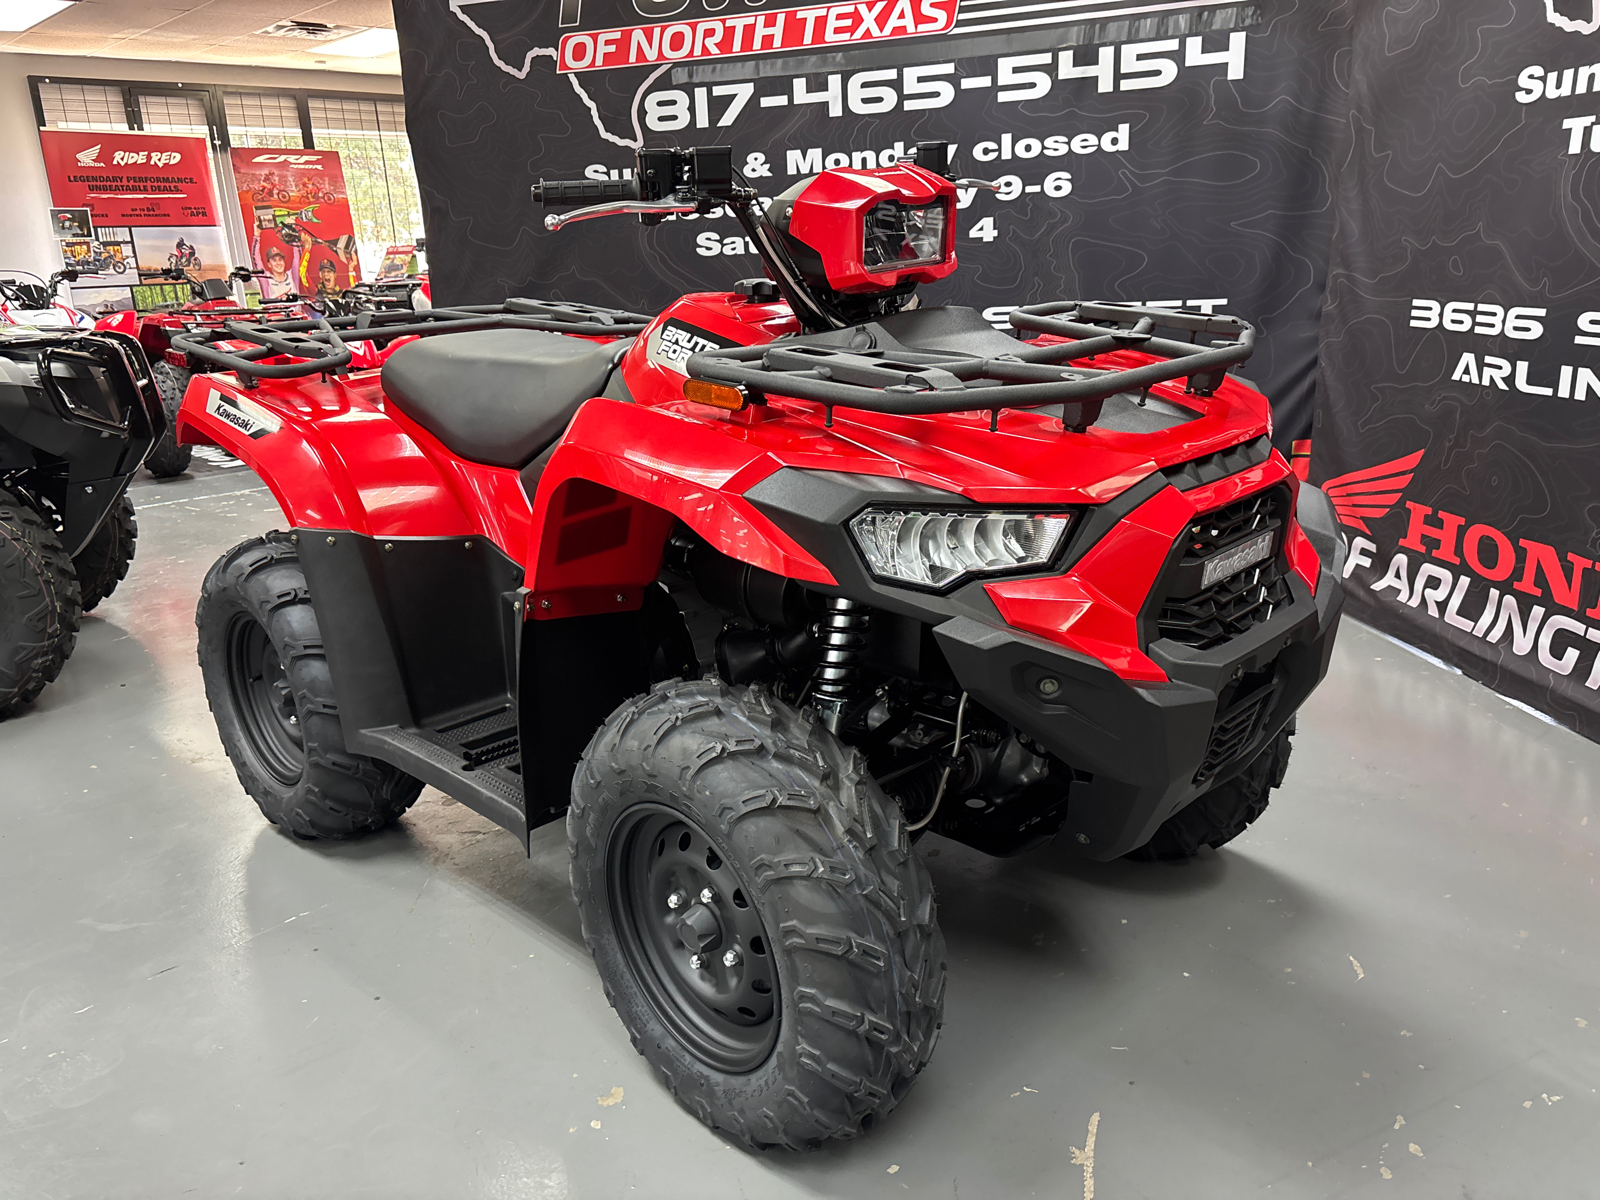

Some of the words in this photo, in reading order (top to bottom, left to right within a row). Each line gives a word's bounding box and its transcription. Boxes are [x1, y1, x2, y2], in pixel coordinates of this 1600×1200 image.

[564, 31, 621, 69] OF
[628, 14, 786, 63] NORTH
[796, 0, 951, 44] TEXAS
[644, 31, 1246, 132] 817-465-5454
[112, 151, 148, 166] RIDE
[150, 151, 182, 168] RED
[251, 154, 323, 163] CRF
[743, 152, 773, 178] &
[972, 123, 1130, 162] closed
[67, 175, 124, 184] LEGENDARY
[126, 176, 197, 185] PERFORMANCE.
[87, 184, 149, 192] UNBEATABLE
[150, 185, 183, 193] DEALS.
[995, 171, 1072, 201] 9-6
[189, 210, 208, 218] APR
[968, 216, 998, 242] 4
[1409, 298, 1548, 341] 3636
[656, 339, 693, 363] FOR
[214, 403, 255, 433] Kawasaki
[1204, 534, 1271, 585] Kawasaki
[1398, 500, 1600, 621] HON
